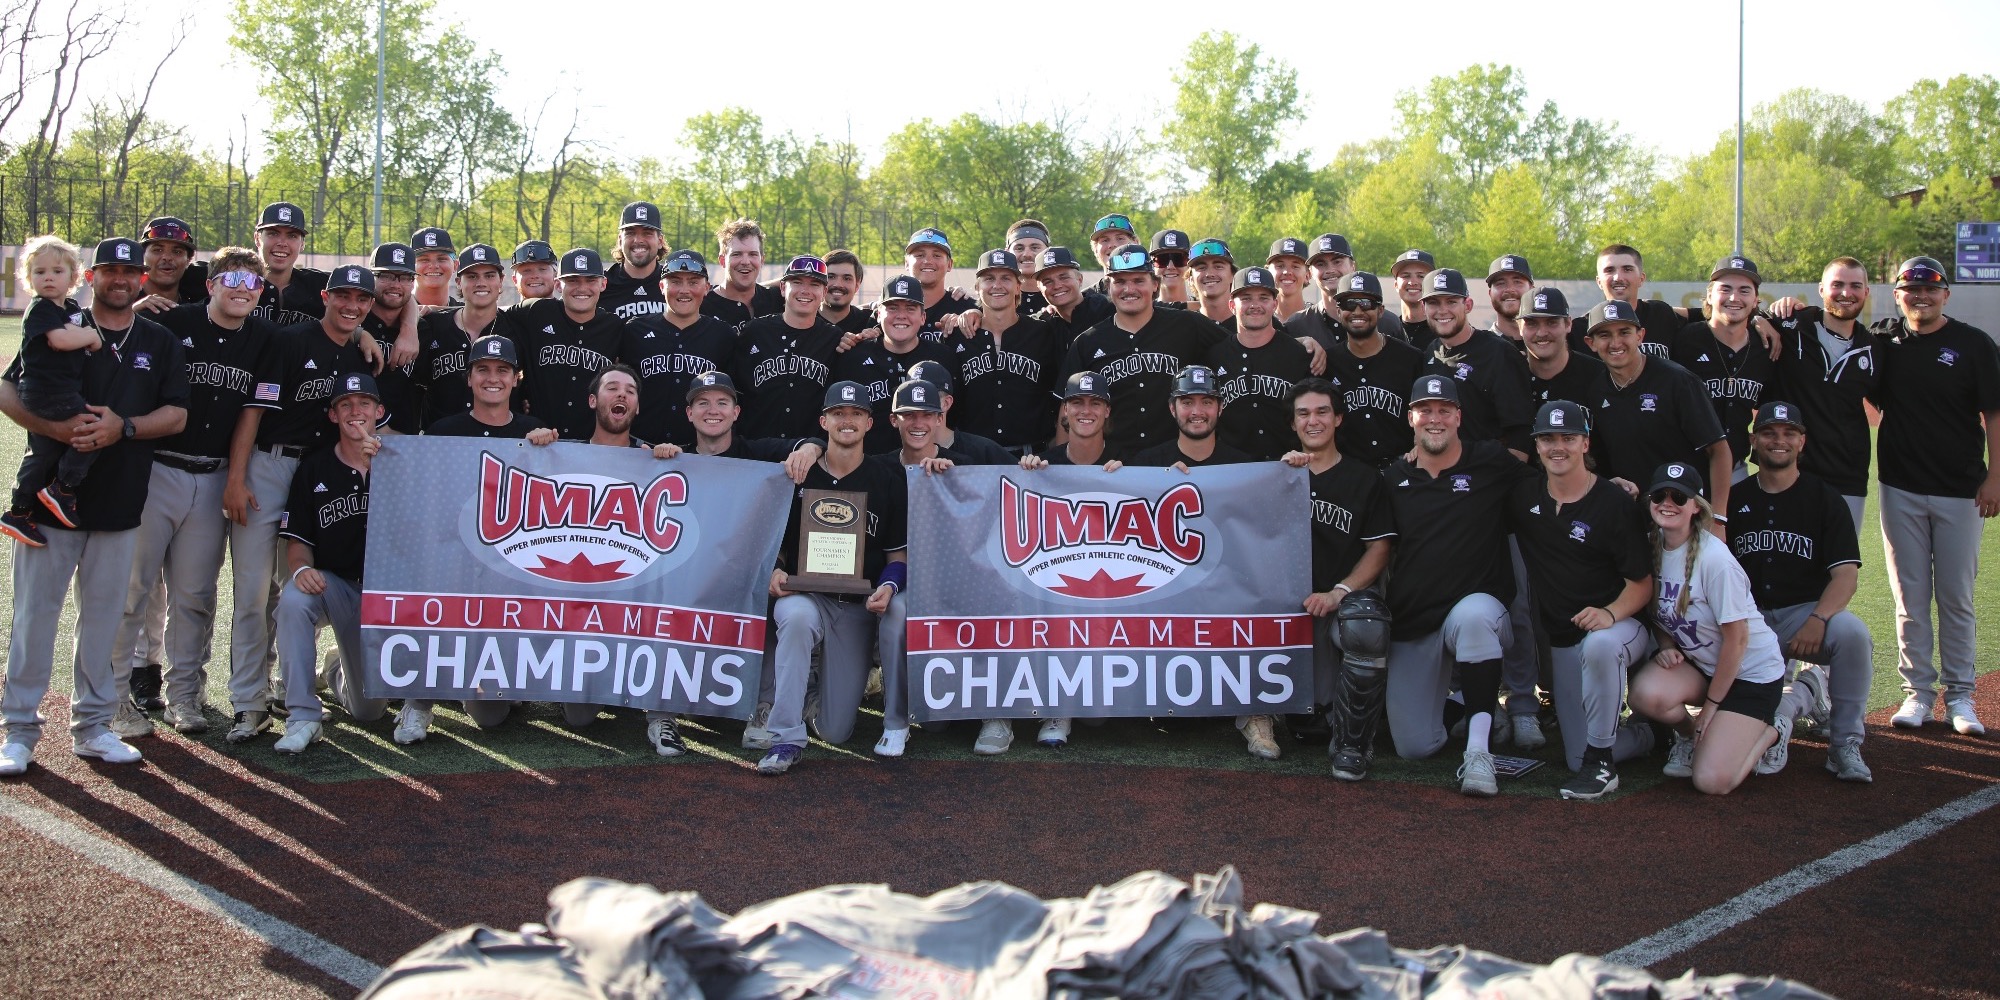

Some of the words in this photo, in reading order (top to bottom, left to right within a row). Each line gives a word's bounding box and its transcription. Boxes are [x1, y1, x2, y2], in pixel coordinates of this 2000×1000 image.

[754, 354, 830, 388] CROWN
[962, 351, 1040, 386] CROWN
[1101, 352, 1178, 386] CROWN
[1344, 386, 1402, 418] ROWN
[477, 450, 688, 554] UMAC
[1000, 474, 1205, 568] UMAC
[504, 544, 530, 556] UPPER
[530, 536, 568, 548] MIDWEST
[569, 534, 606, 546] ATHLETIC
[608, 540, 652, 564] CONFERENCE
[1735, 530, 1813, 560] CROWN
[1027, 560, 1050, 576] UPPER
[1050, 553, 1086, 566] MIDWEST
[1088, 551, 1124, 561] ATHLETIC
[1126, 553, 1176, 576] CONFERENCE
[385, 596, 752, 646] TOURNAMENT
[924, 618, 1292, 648] TOURNAMENT
[380, 633, 746, 706] CHAMPIONS
[924, 654, 1294, 710] CHAMPIONS
